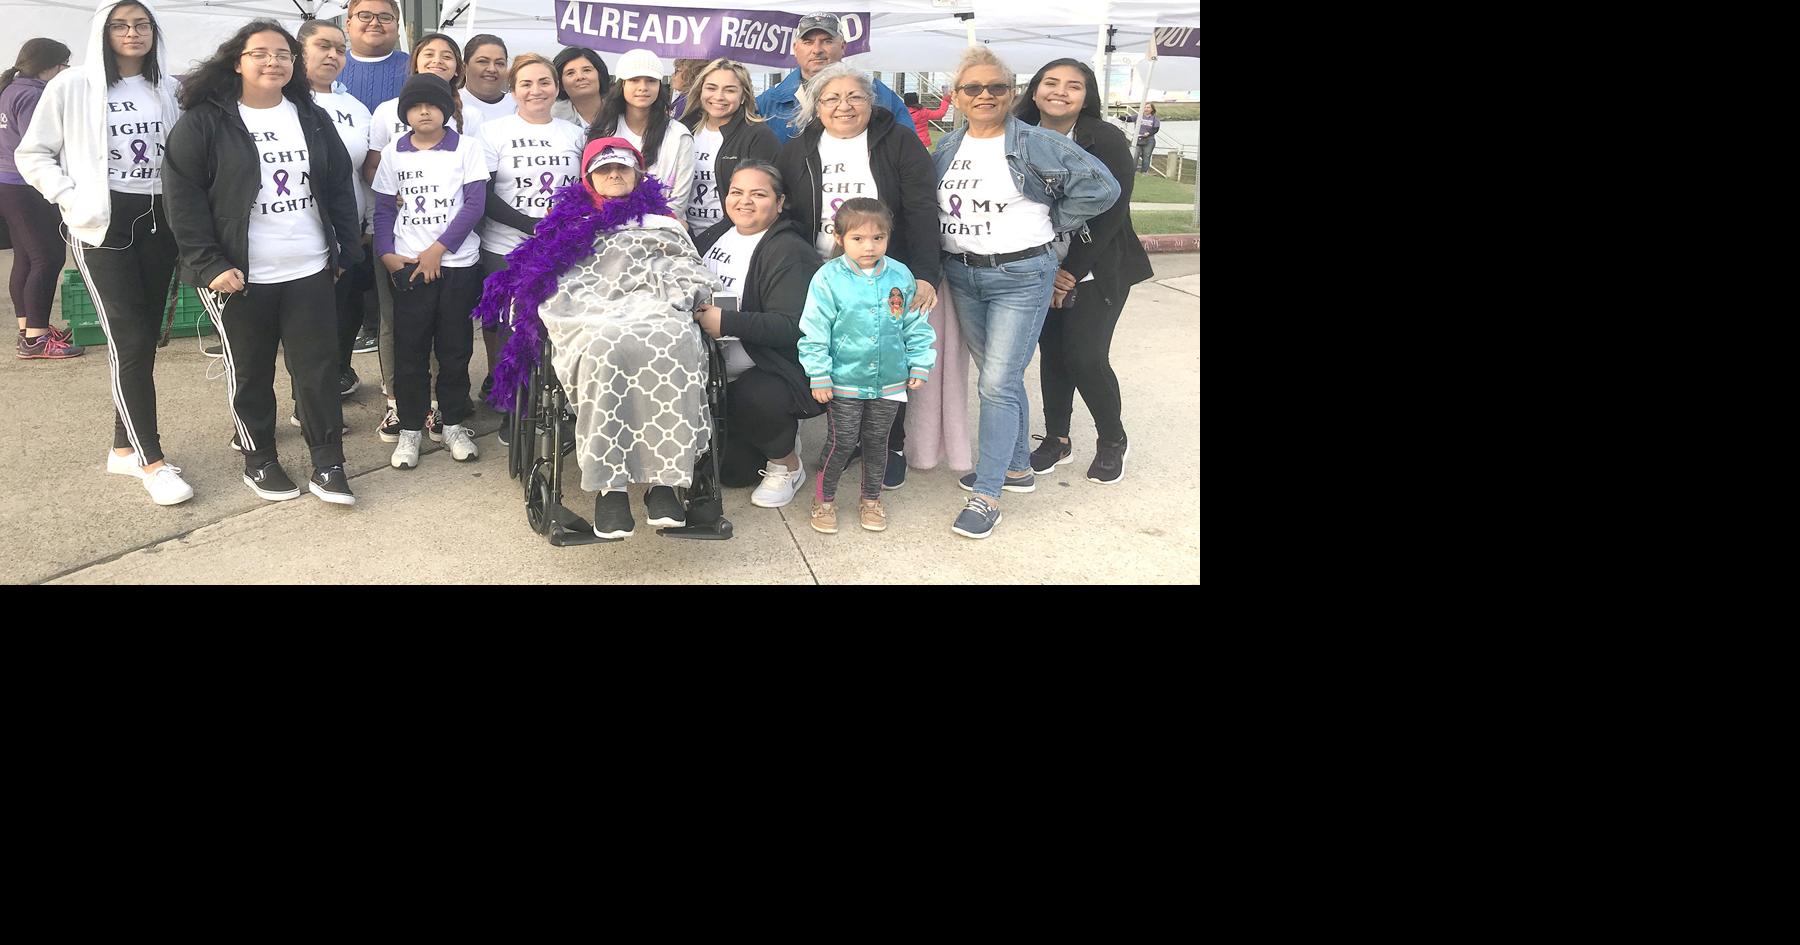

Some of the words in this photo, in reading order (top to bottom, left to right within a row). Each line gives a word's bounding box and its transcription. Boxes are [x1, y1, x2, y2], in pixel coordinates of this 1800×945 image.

[560, 1, 711, 45] ALREADY
[720, 13, 863, 55] REGISTD
[108, 101, 138, 113] ER
[110, 121, 163, 136] IGHT
[249, 131, 279, 142] ER
[263, 150, 307, 163] GHT
[513, 155, 571, 169] FIGHT
[822, 162, 846, 174] ER
[951, 160, 972, 170] ER
[397, 170, 424, 181] HER
[821, 182, 866, 193] GHT
[938, 179, 982, 190] IGHT
[260, 194, 314, 215] IGHT!
[688, 206, 720, 218] GHT
[941, 221, 992, 236] IGHT!
